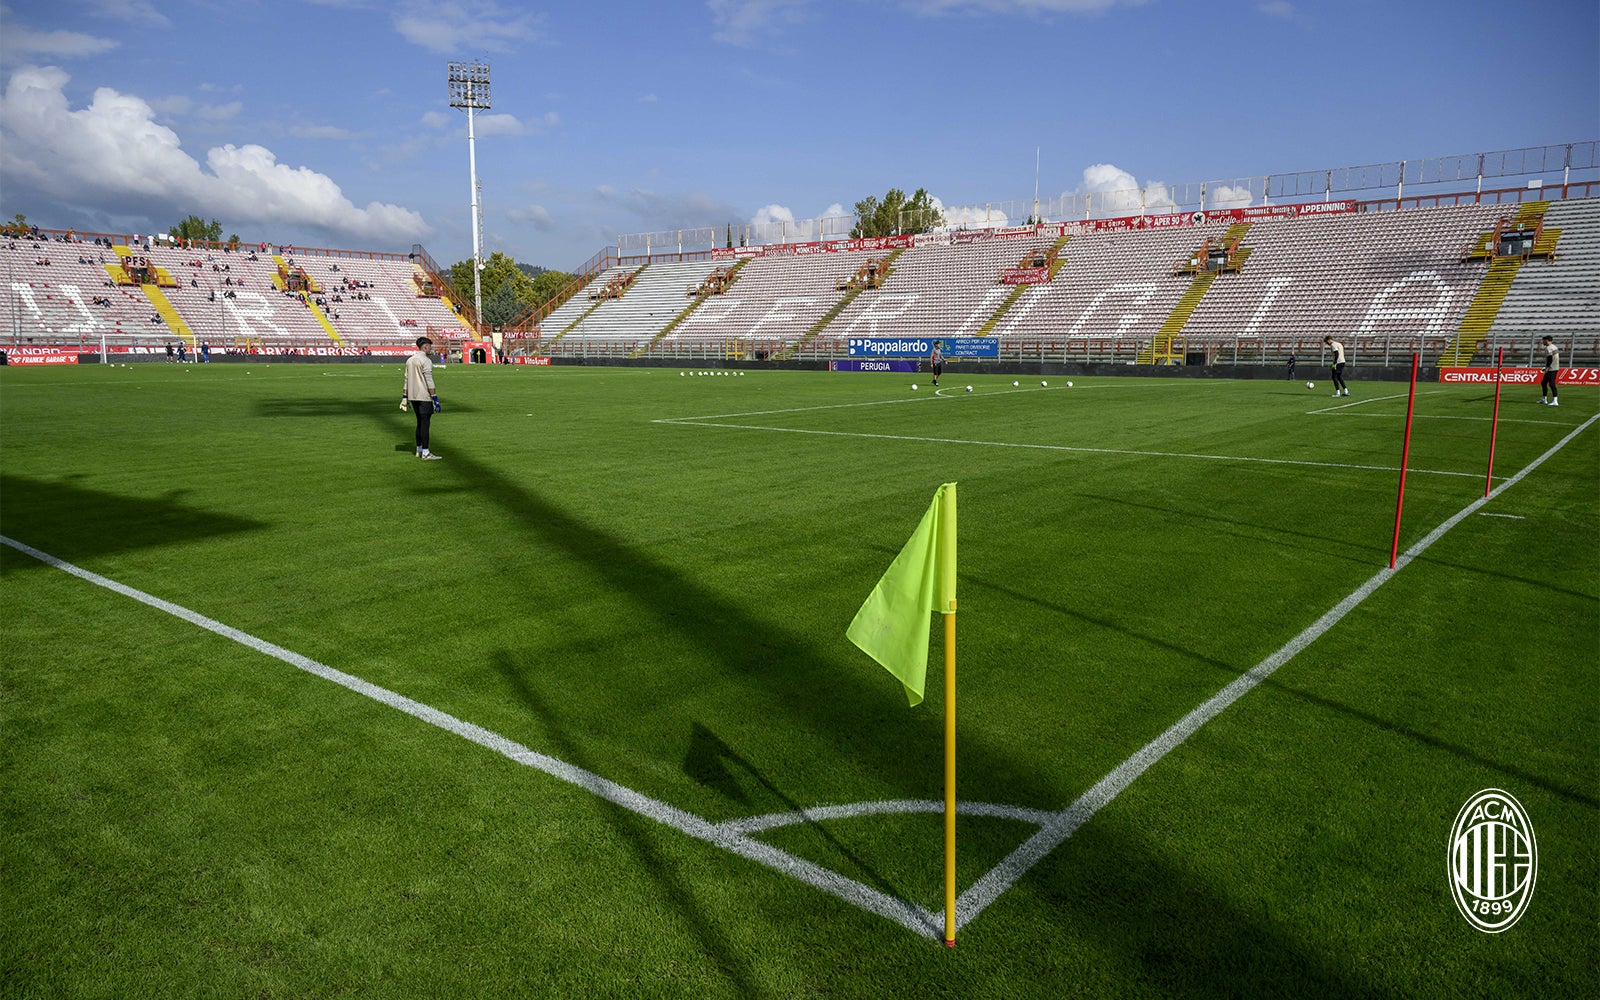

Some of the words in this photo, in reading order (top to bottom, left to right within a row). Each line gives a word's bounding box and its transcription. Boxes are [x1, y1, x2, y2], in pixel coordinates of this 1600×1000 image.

[1299, 203, 1346, 214] APPENNINO
[125, 256, 146, 267] PFS
[864, 339, 928, 355] Pappalardo
[524, 356, 549, 365] Vitakraft
[860, 362, 891, 371] PERUGIA
